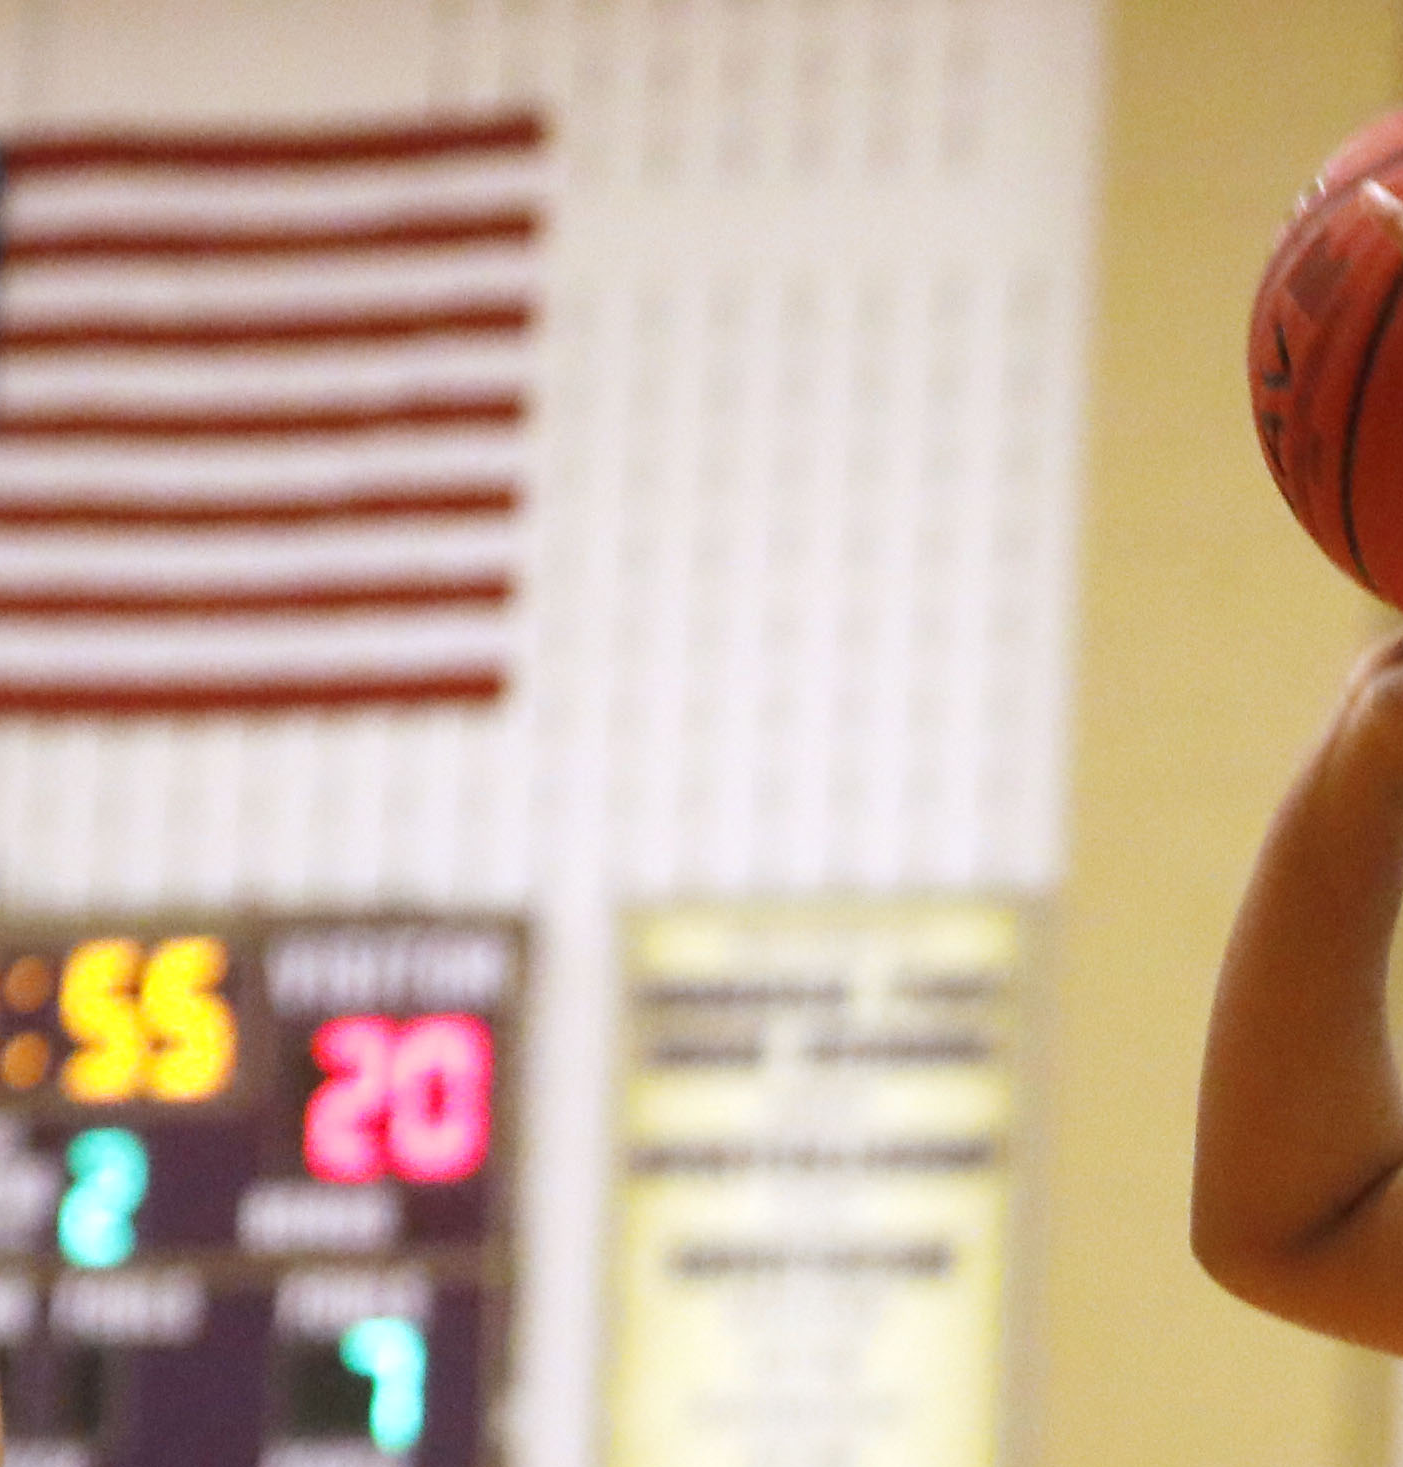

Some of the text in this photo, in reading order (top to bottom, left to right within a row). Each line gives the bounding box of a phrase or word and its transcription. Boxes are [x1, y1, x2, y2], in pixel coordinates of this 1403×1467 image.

[303, 1011, 495, 1185] 20
[57, 1125, 149, 1270] 2
[339, 1315, 428, 1456] 7
